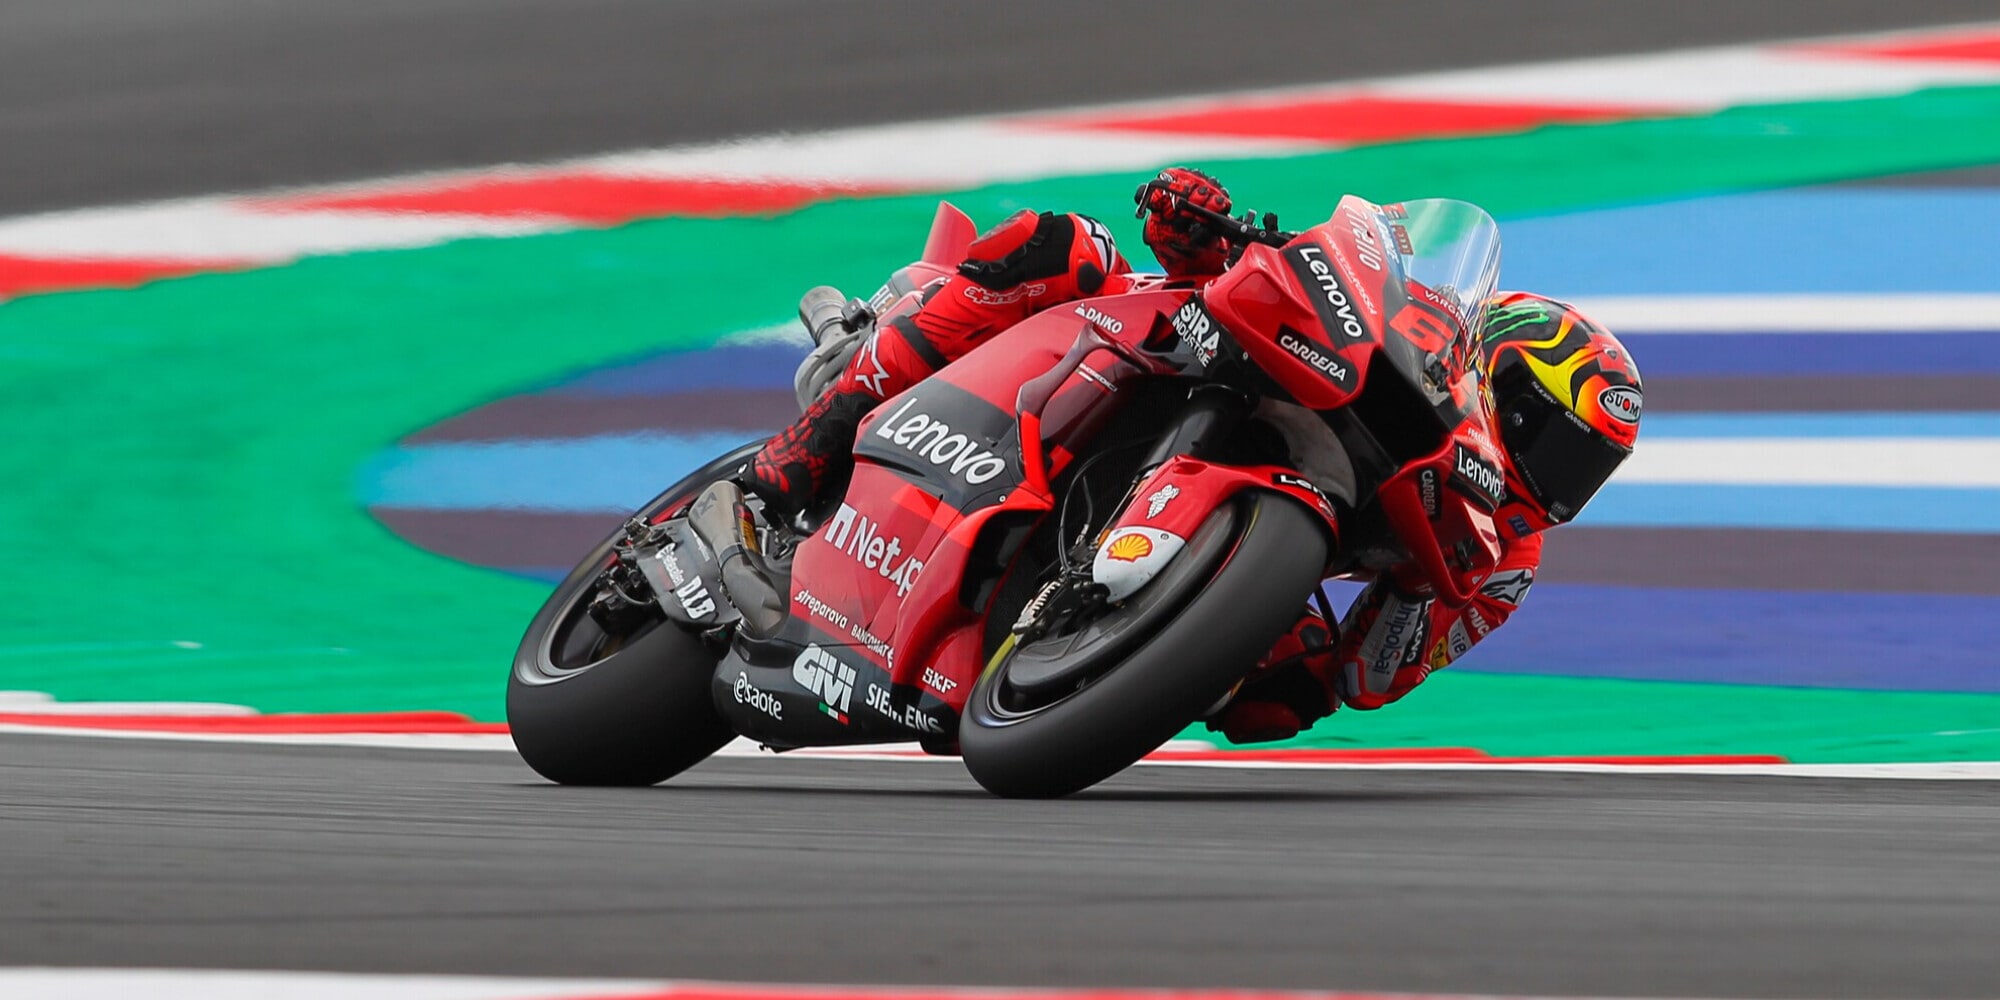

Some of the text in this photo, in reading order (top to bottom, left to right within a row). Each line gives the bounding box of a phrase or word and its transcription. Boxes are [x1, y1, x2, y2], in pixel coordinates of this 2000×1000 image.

[1299, 247, 1363, 337] Lenovo
[1086, 307, 1123, 334] DAIKO
[1172, 314, 1212, 368] INDUSTRIE
[1280, 335, 1347, 382] CARRERA
[1606, 389, 1641, 418] SUOM
[876, 397, 1006, 484] Lenovo
[1457, 446, 1501, 497] Lenovo
[794, 590, 849, 629] streparava
[851, 623, 890, 657] BANCOMAT
[792, 642, 857, 714] GIVI
[922, 666, 958, 693] SKF
